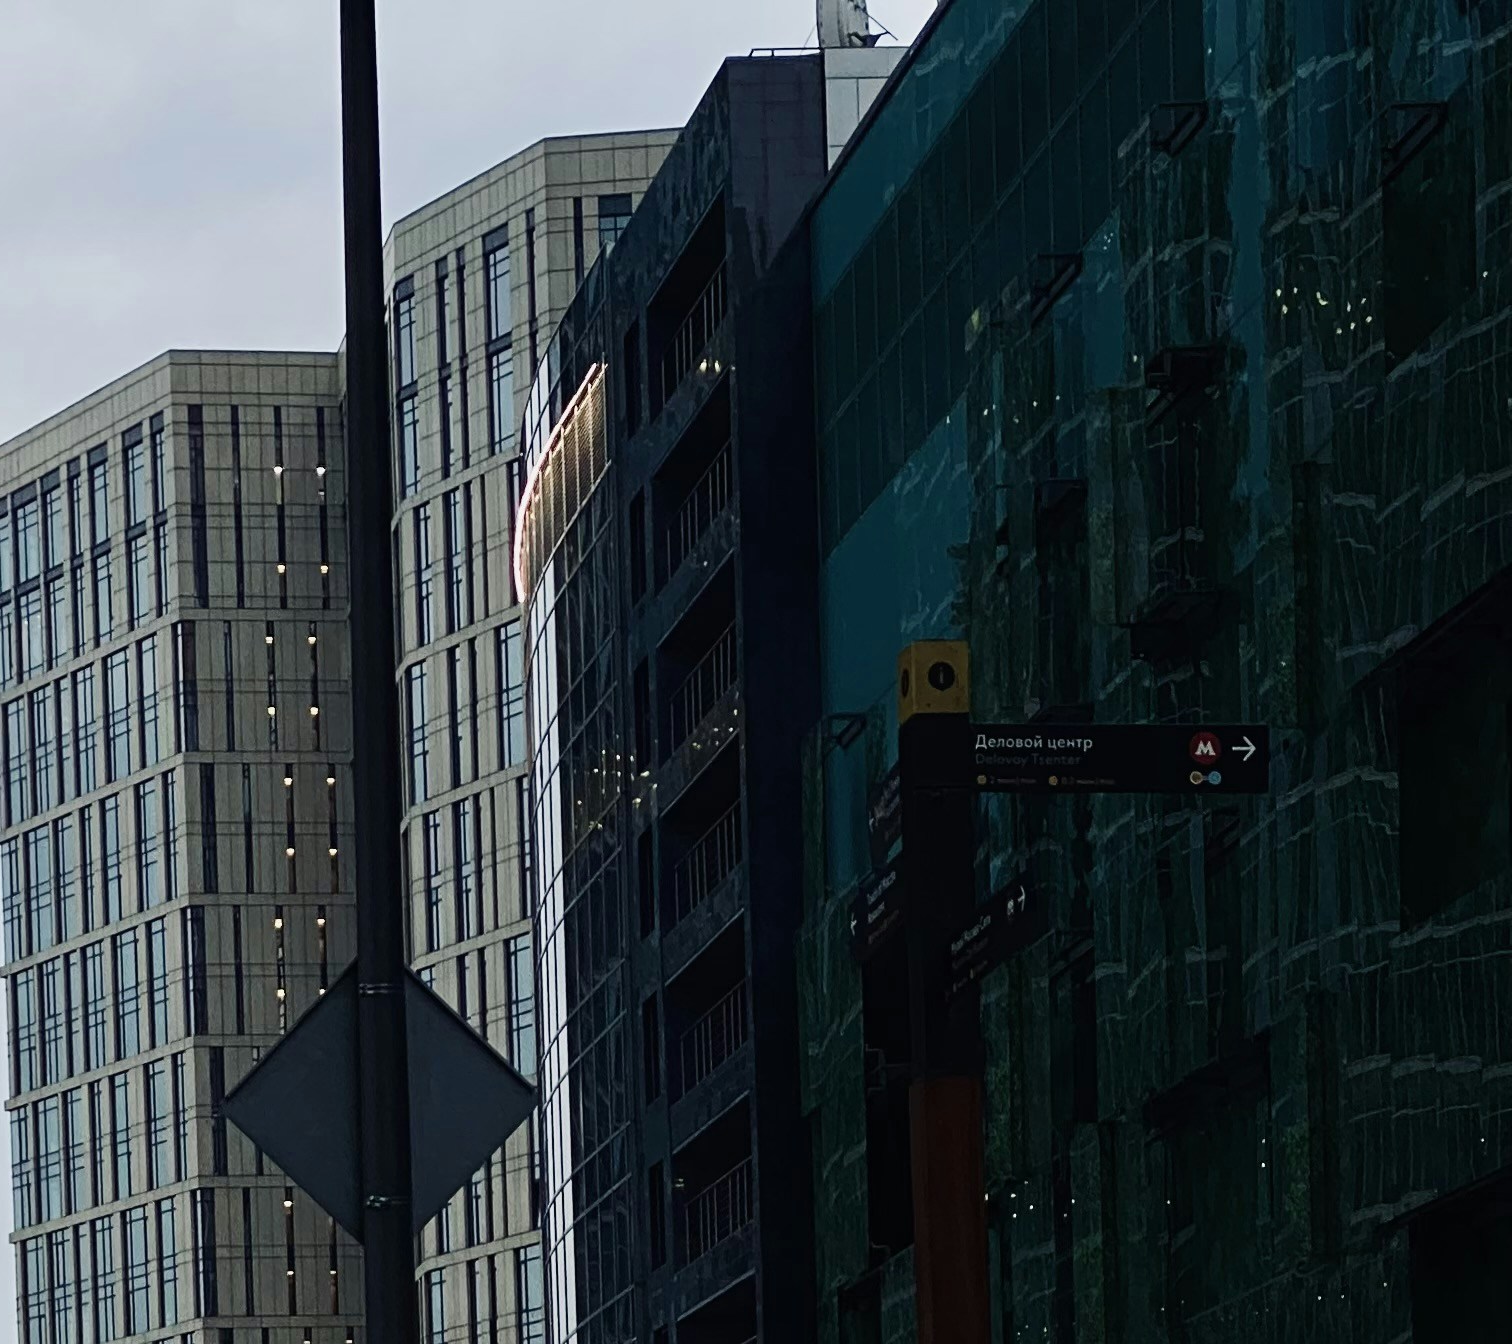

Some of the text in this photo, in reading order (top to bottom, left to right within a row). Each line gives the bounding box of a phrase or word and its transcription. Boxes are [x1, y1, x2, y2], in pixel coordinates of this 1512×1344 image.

[975, 733, 1093, 752] Деловой центр
[975, 753, 1081, 767] Delovoy Tsenter
